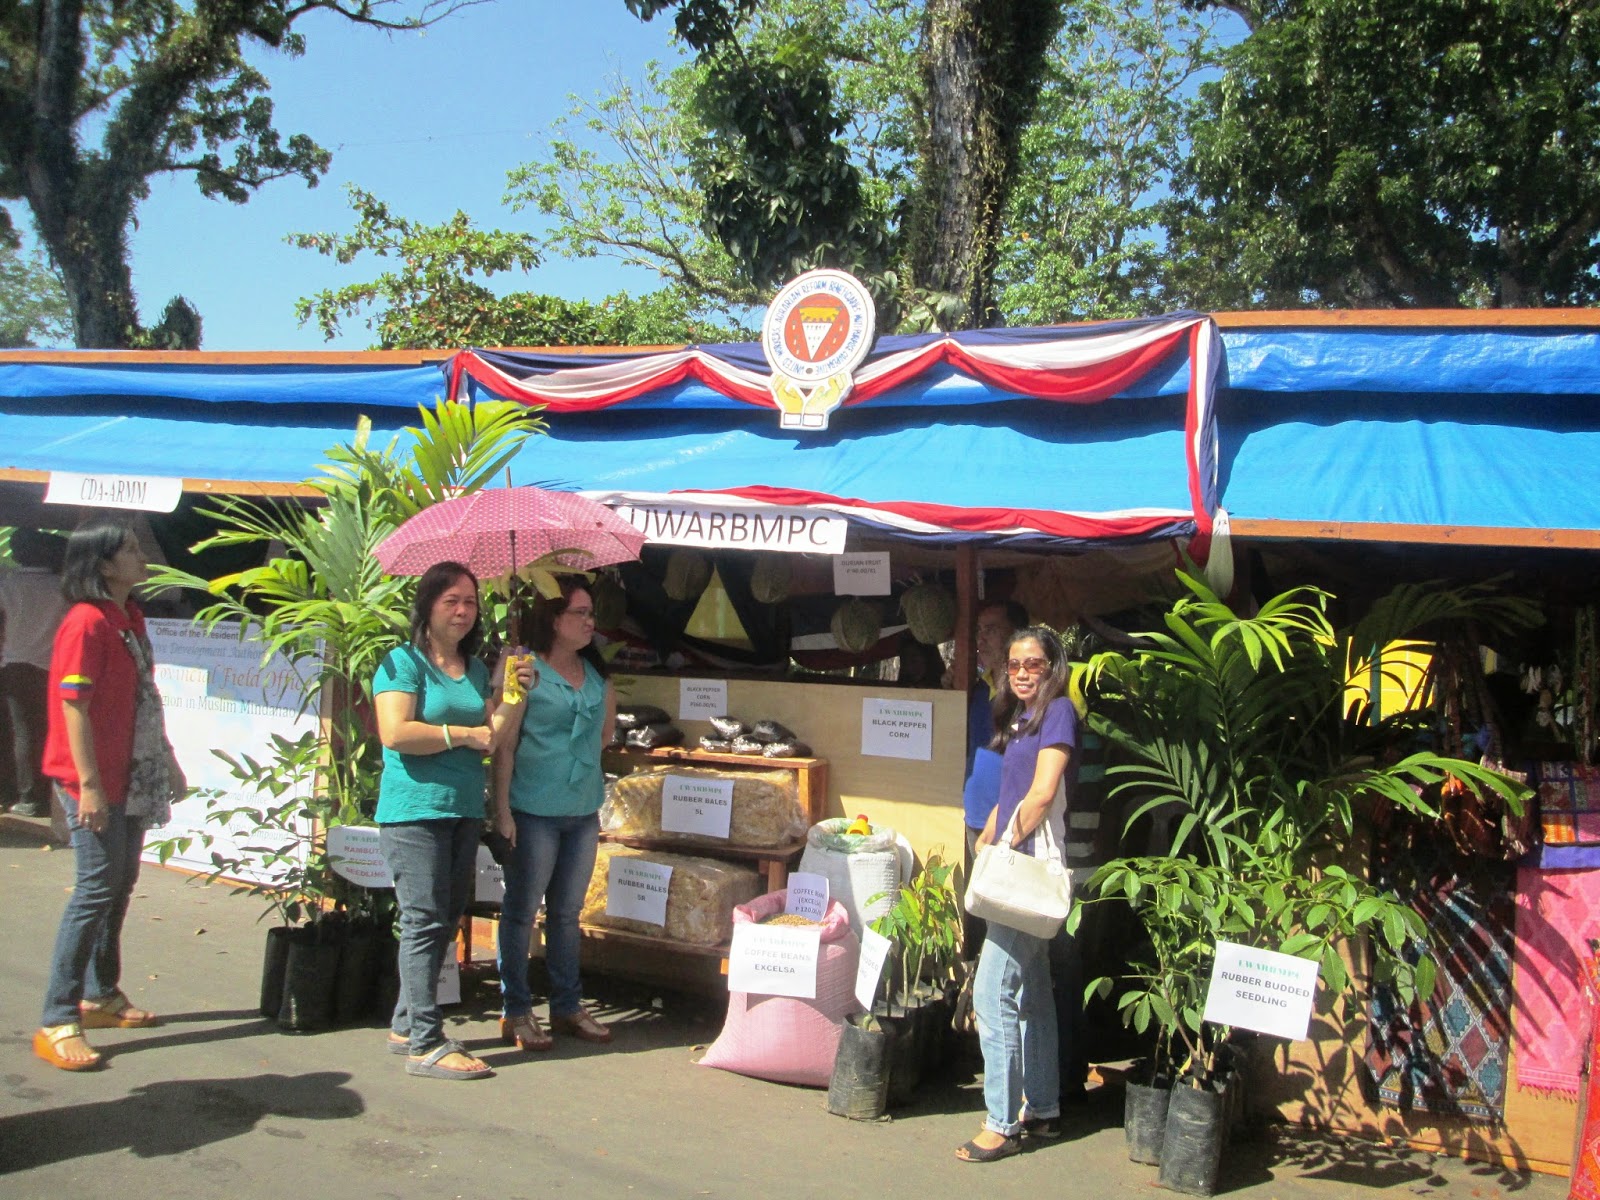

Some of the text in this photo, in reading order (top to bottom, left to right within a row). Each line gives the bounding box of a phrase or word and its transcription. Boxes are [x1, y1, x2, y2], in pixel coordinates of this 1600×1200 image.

[775, 288, 801, 323] AGRARIAN
[801, 280, 827, 293] REFORM
[630, 507, 831, 546] UWARBMPC
[156, 627, 239, 640] Office of the Pesident
[219, 665, 260, 690] Field
[185, 696, 196, 709] in
[199, 695, 237, 713] Muslim
[239, 699, 296, 718] Mindanao
[872, 719, 927, 729] BLACK PEPPER
[889, 731, 910, 739] CORN
[672, 794, 728, 806] RUBBER BALES
[344, 845, 380, 855] RAMBUT
[618, 878, 667, 894] RUBBER BALES
[793, 888, 814, 896] COFFEE
[744, 947, 812, 961] COFFEE BEANS
[754, 963, 796, 974] EXCELSA
[1221, 971, 1310, 998] RUBBER BUDDED
[1235, 990, 1288, 1008] SEEDLING
